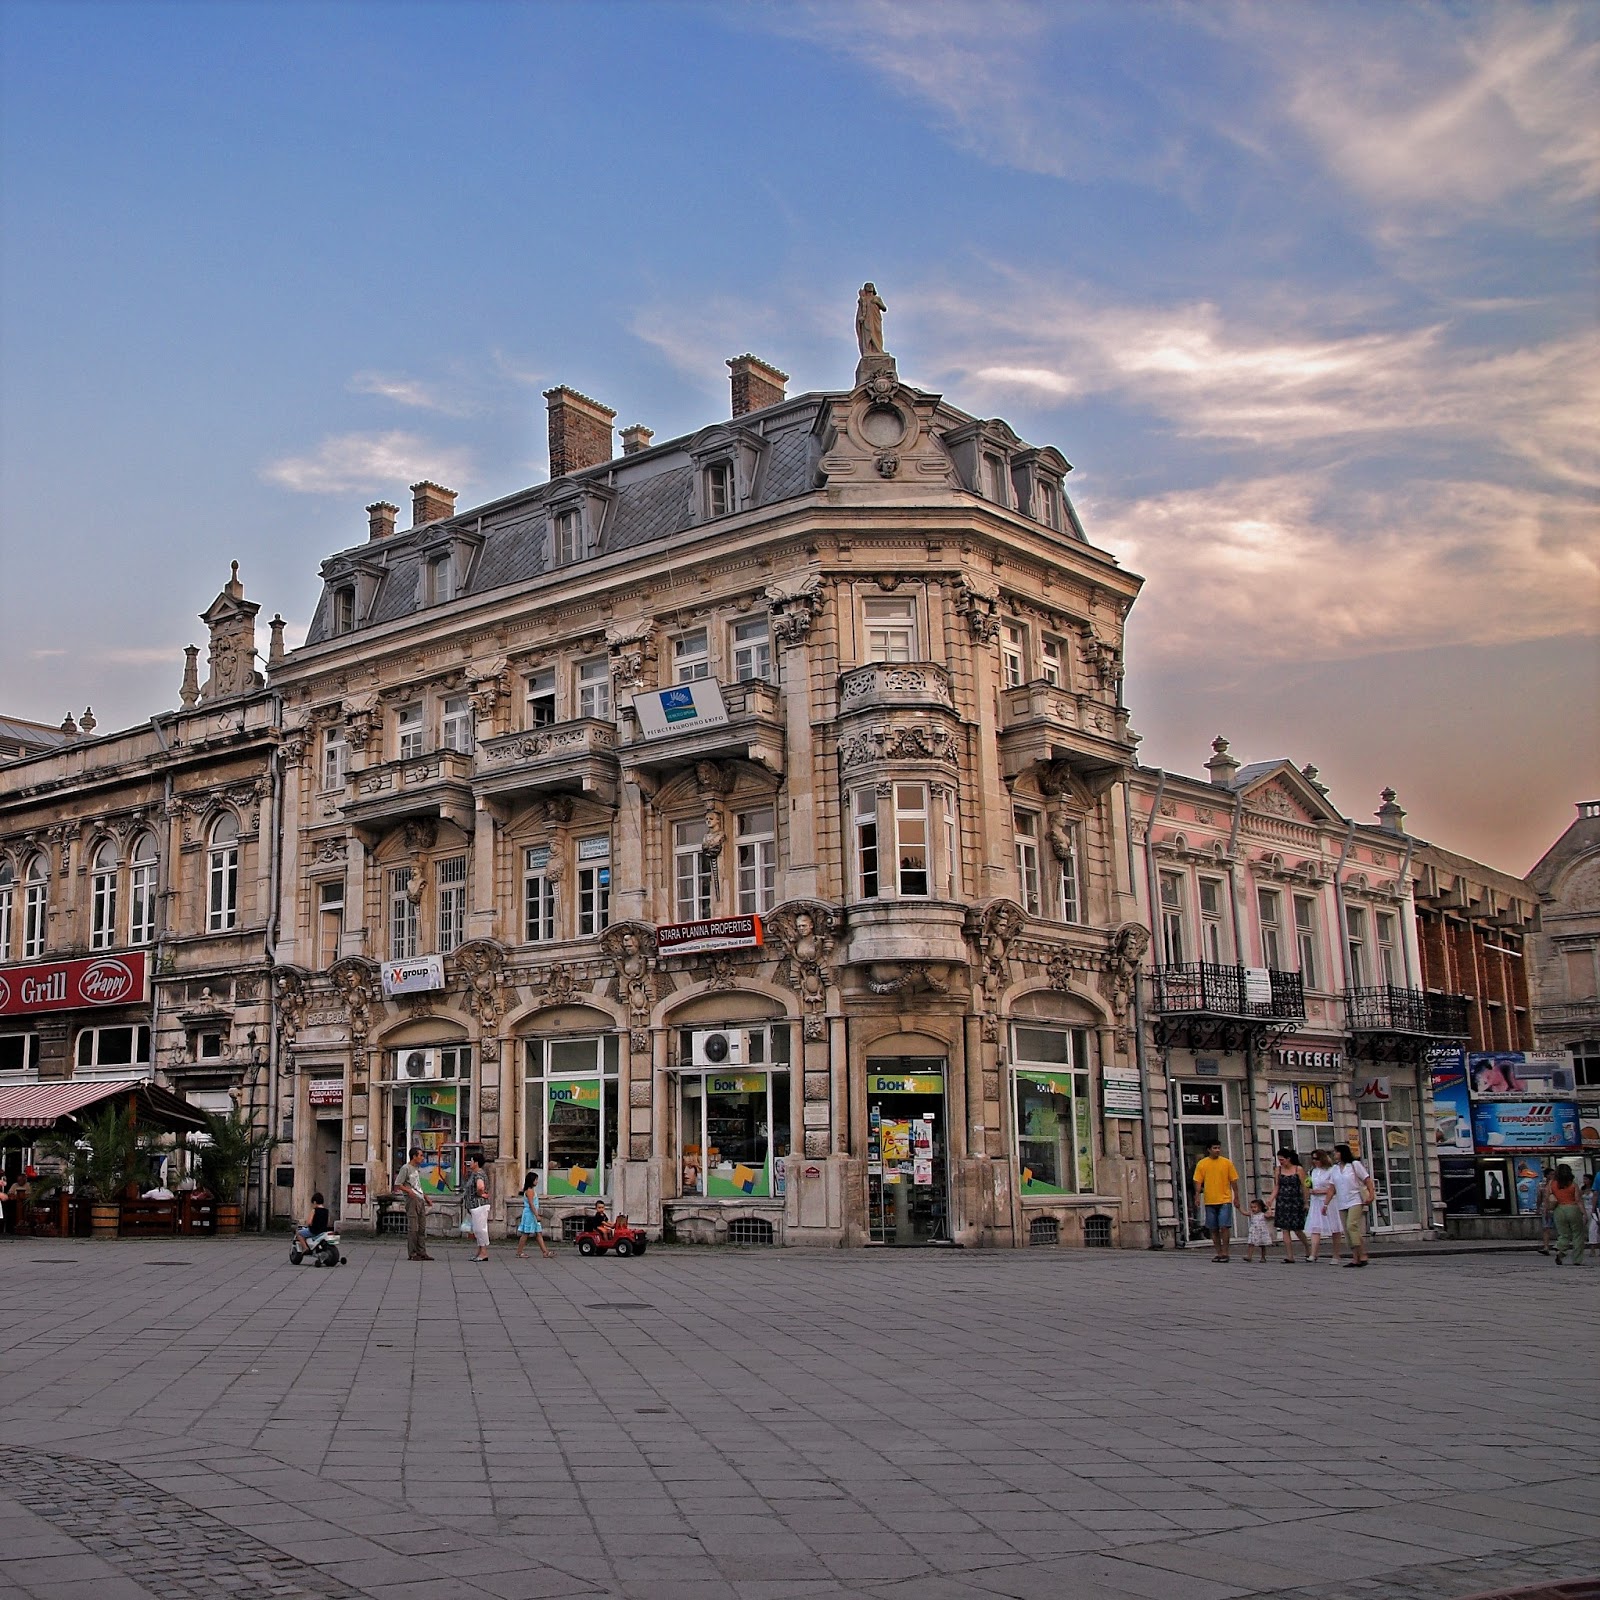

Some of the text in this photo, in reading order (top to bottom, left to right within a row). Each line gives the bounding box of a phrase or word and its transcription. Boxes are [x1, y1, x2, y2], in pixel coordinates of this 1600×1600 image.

[647, 719, 704, 736] РЕГИСТРАЦИОННО
[659, 919, 753, 941] STARA PLANINA PROPERTIES
[21, 971, 67, 1004] Grill
[84, 969, 126, 997] Happy
[1278, 1049, 1341, 1068] ТЕТЕВЕН
[1497, 1115, 1554, 1123] ТЕРМОФЛЕКС
